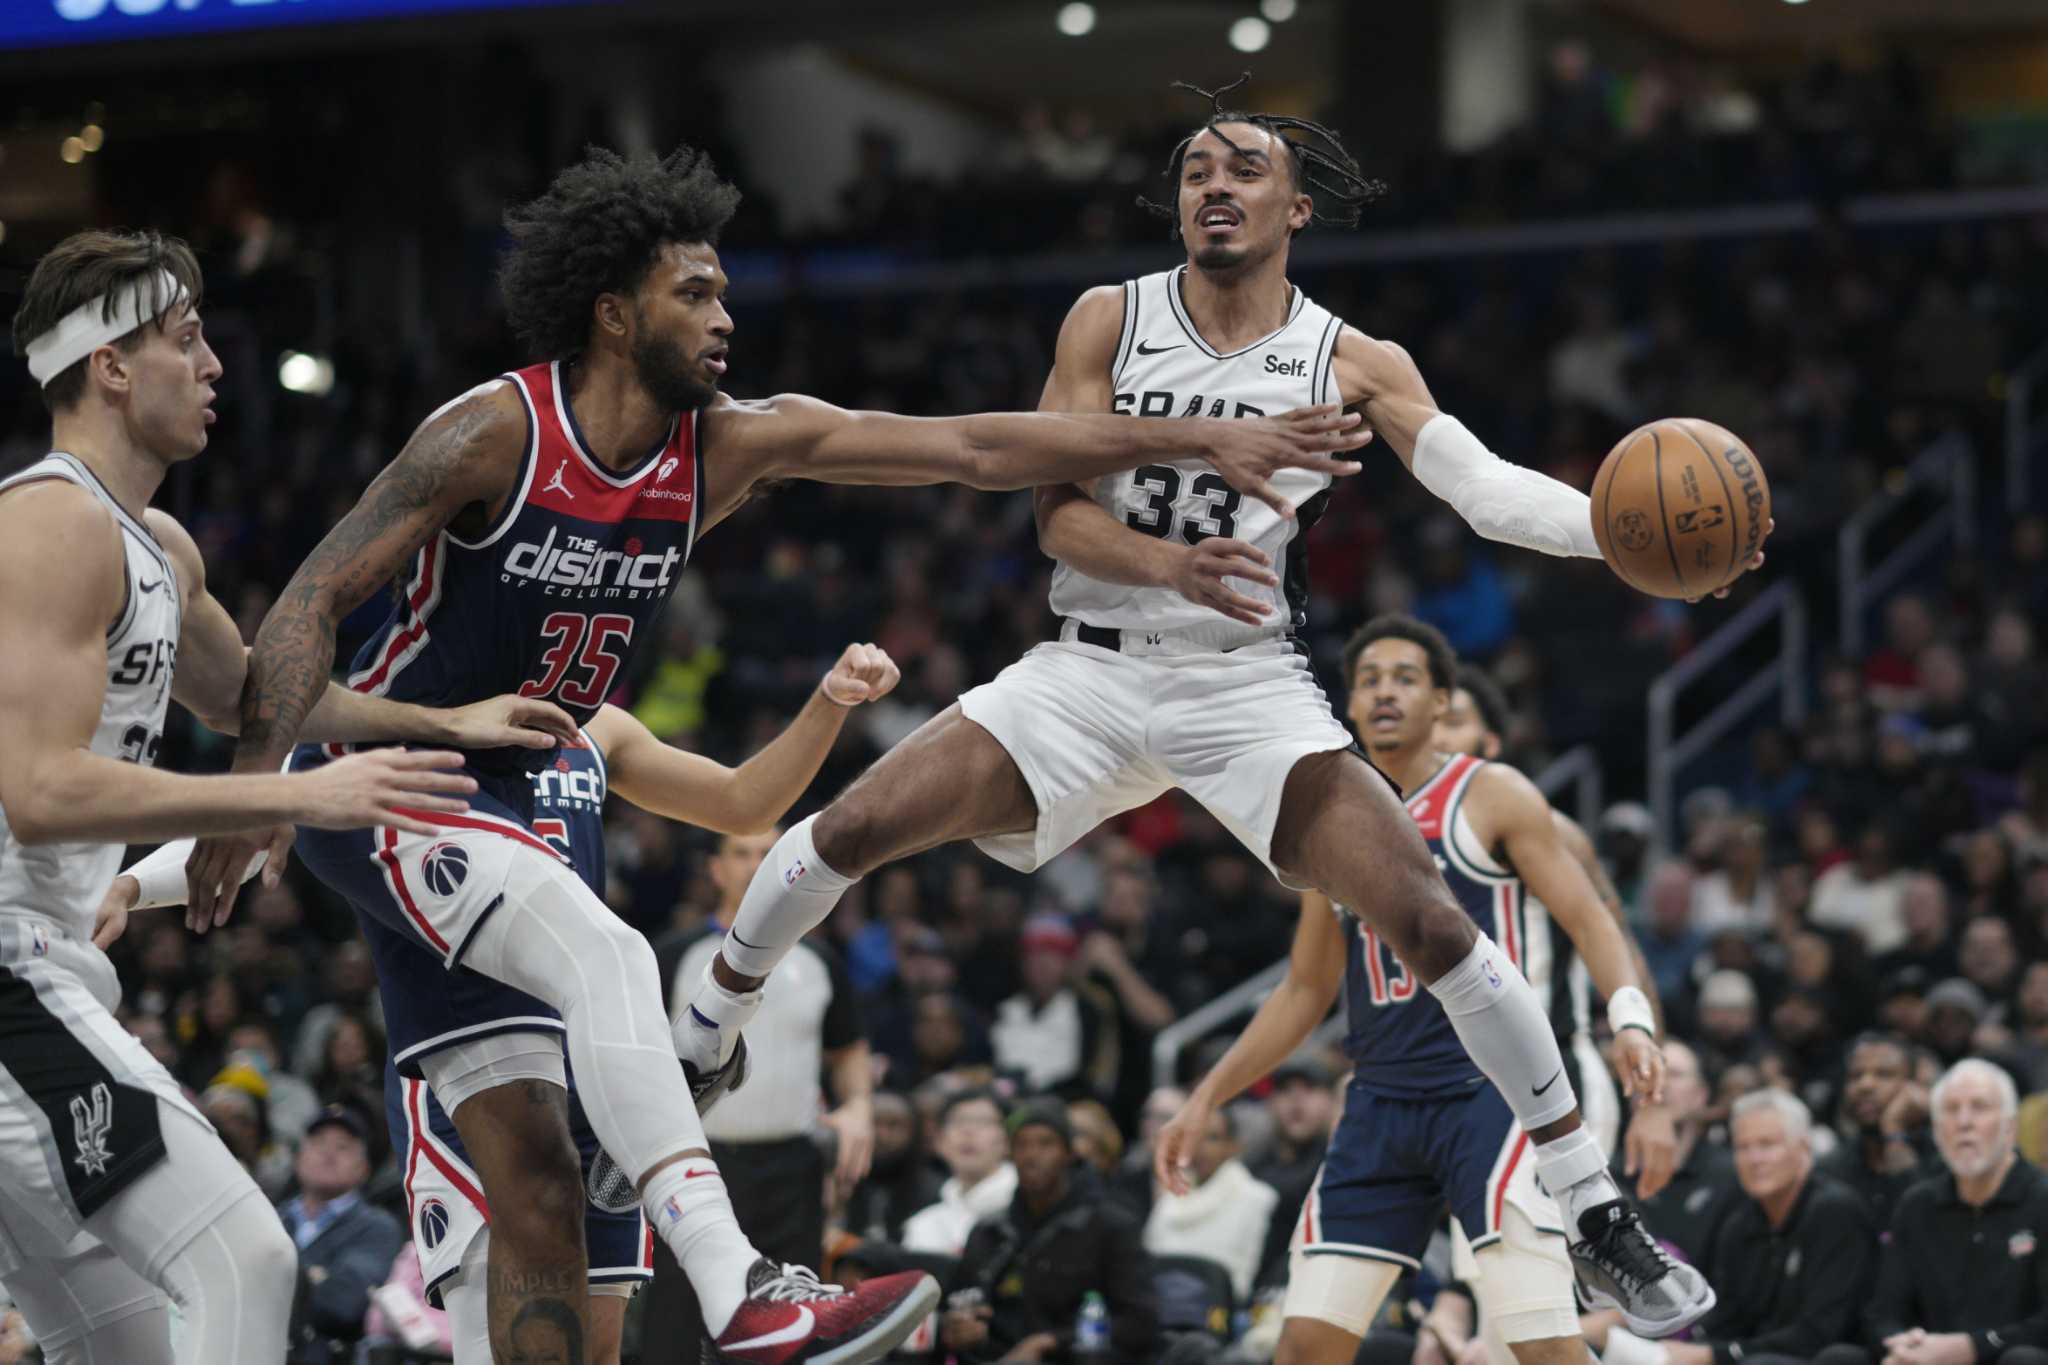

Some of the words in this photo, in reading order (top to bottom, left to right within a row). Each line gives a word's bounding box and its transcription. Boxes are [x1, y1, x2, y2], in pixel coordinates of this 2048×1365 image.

[1264, 354, 1307, 377] Self.
[639, 488, 691, 502] Robinhood
[1127, 464, 1243, 545] 33
[566, 535, 598, 551] THE
[503, 525, 681, 588] district
[500, 573, 527, 588] OF
[518, 611, 634, 709] 35
